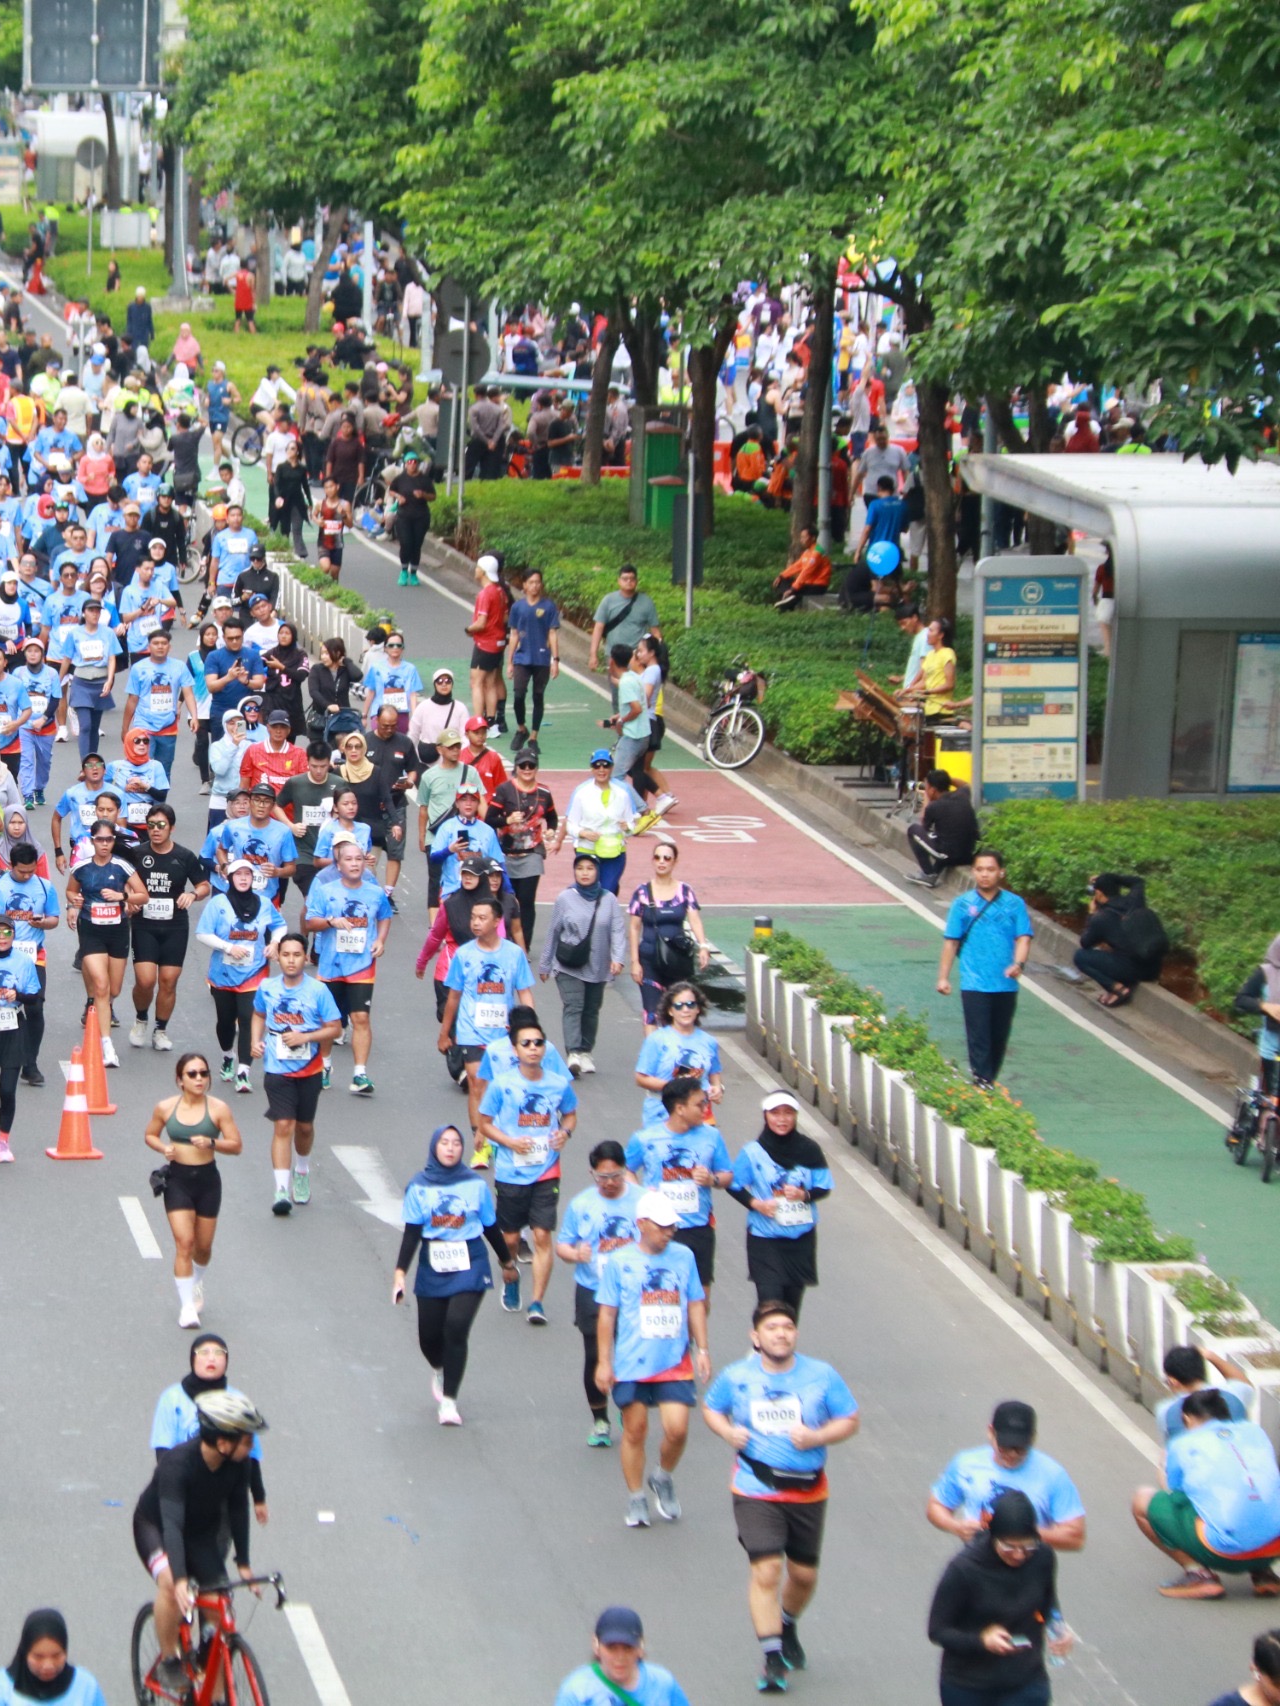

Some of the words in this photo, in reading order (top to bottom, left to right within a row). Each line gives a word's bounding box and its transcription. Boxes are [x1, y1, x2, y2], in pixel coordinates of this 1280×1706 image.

[150, 872, 169, 880] MOVE
[96, 907, 117, 915] 11415
[147, 903, 170, 912] 51418
[340, 936, 365, 944] 51264
[480, 1010, 505, 1018] 51794
[646, 1316, 679, 1326] 50841
[757, 1409, 796, 1422] 51008
